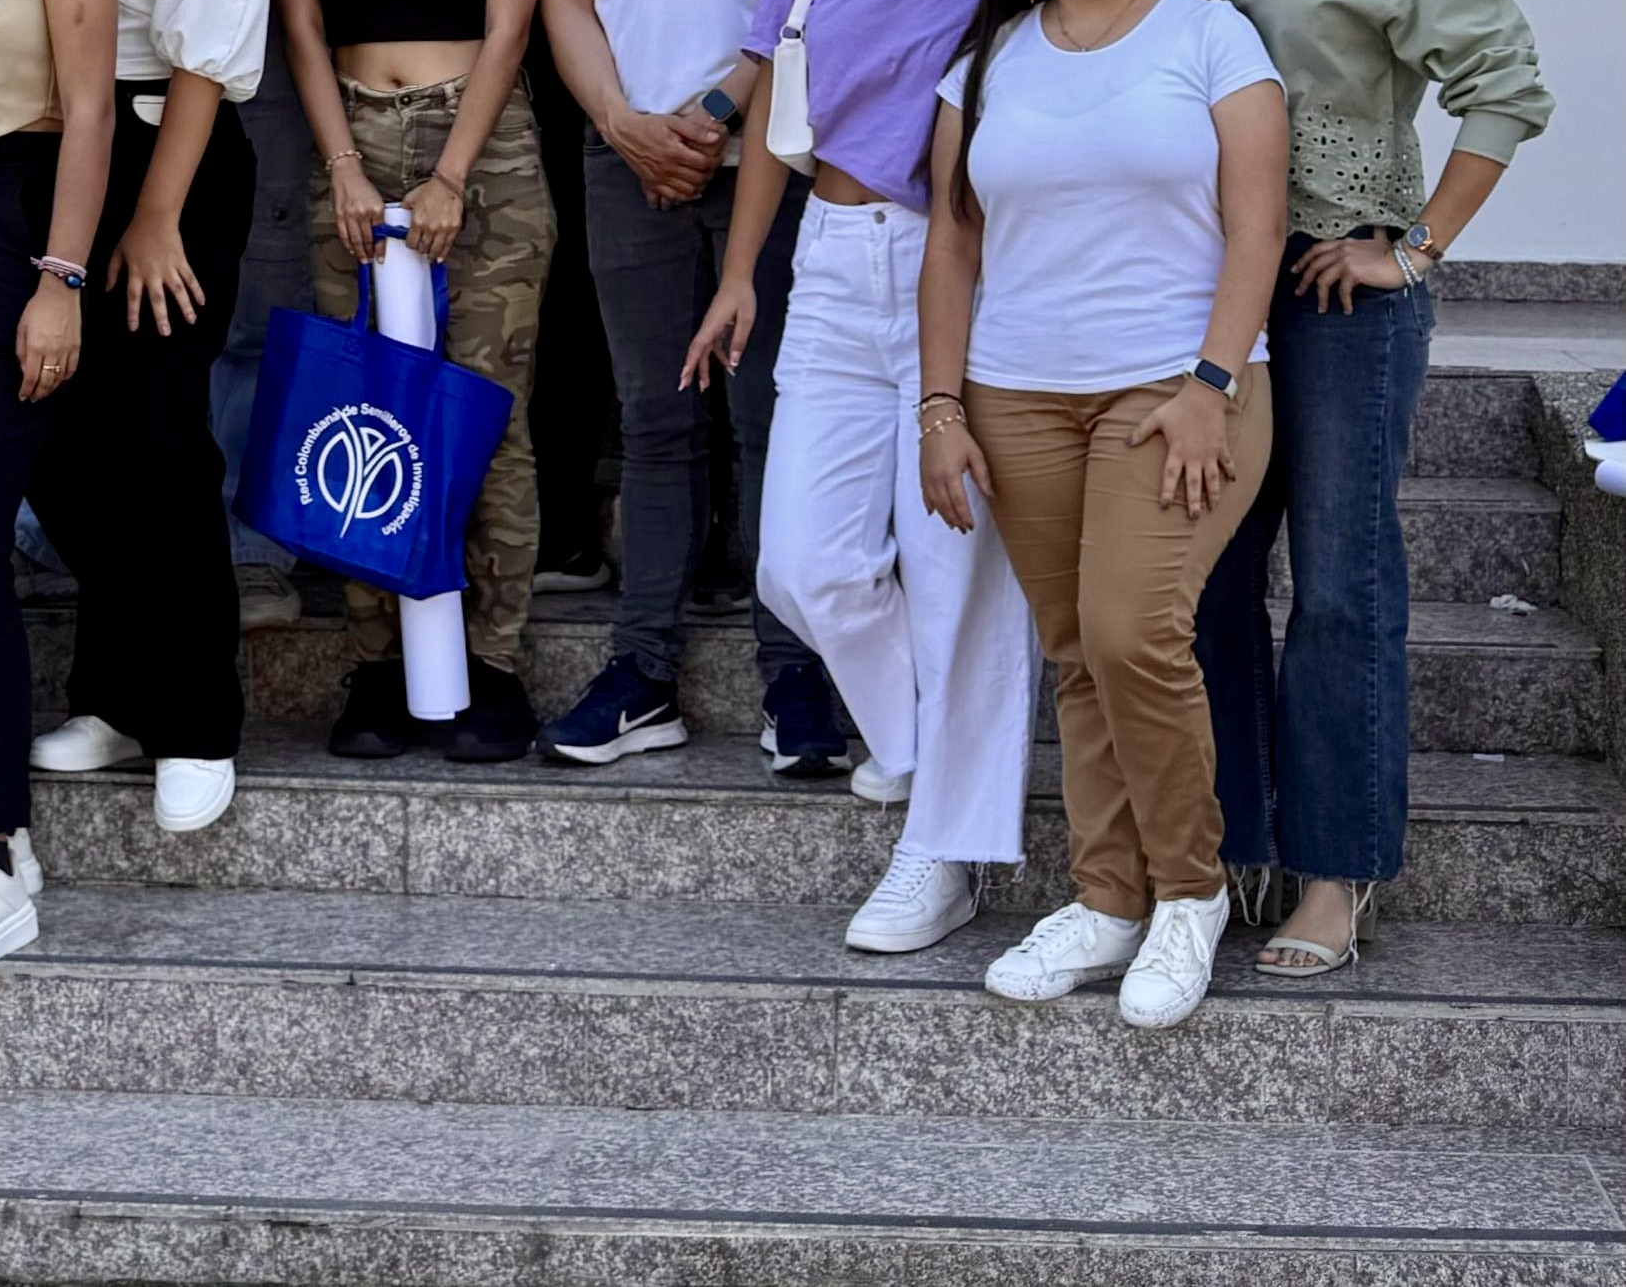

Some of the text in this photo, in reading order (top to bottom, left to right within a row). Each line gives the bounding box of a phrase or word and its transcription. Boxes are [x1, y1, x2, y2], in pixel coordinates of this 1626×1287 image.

[340, 404, 358, 417] de
[294, 408, 340, 476] Colombiana
[407, 443, 419, 460] de
[300, 477, 314, 505] Red
